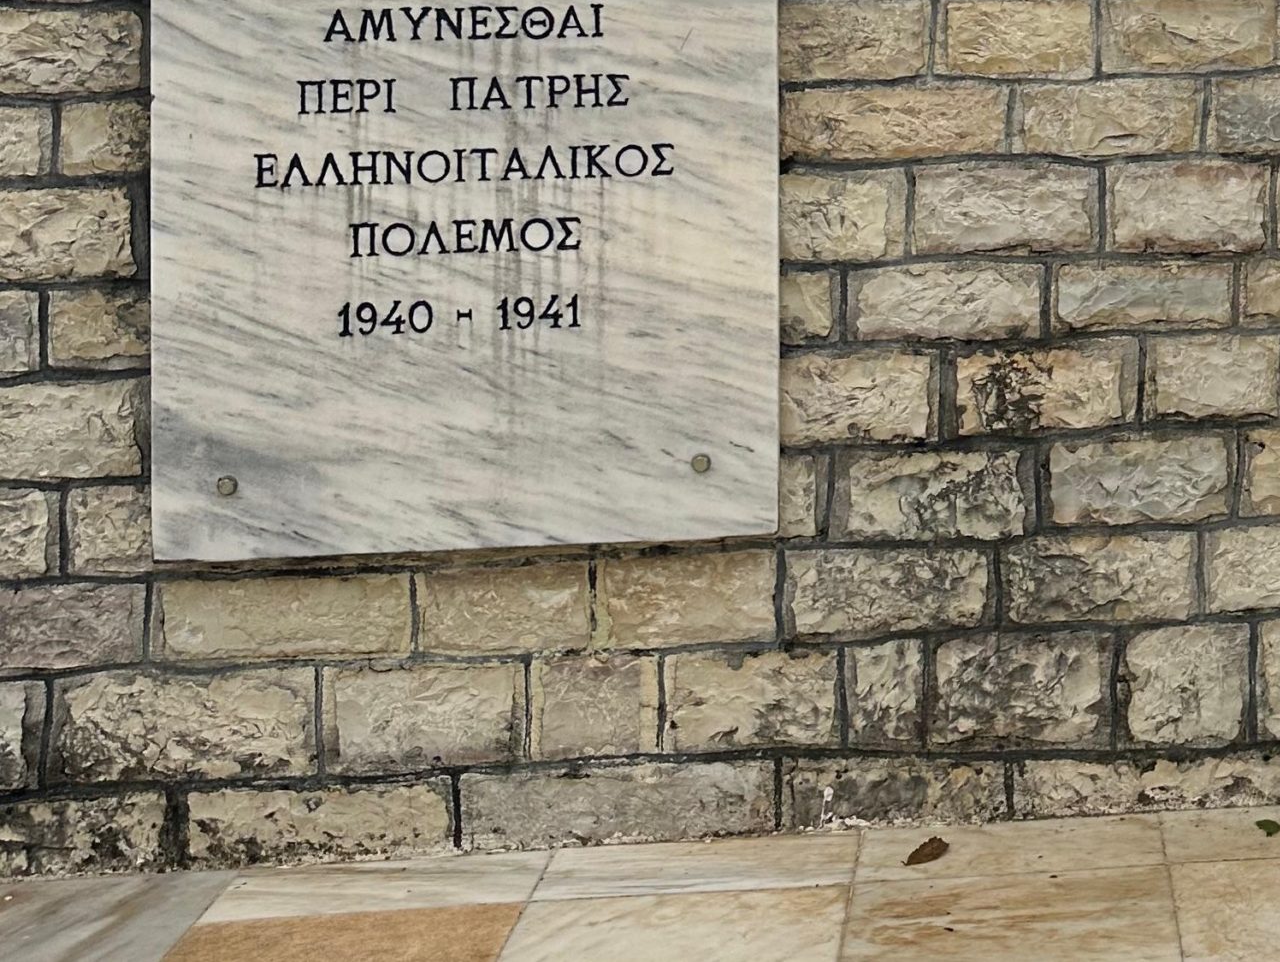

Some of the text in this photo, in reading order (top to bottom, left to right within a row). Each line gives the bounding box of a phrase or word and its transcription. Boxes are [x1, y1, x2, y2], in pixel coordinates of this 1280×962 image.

[322, 3, 605, 44] ΑΜΥΝΕΣΘΑΙ
[295, 73, 630, 116] ΠΕΡΙ ΠΑΤΡΗΣ
[253, 142, 676, 189] ΕΛΛΗΝΟΙΤΑΛΙΚΟΣ
[347, 216, 582, 259] ΠΟΛΕΜΟΣ
[337, 299, 434, 338] 1940
[495, 293, 582, 332] 1941
